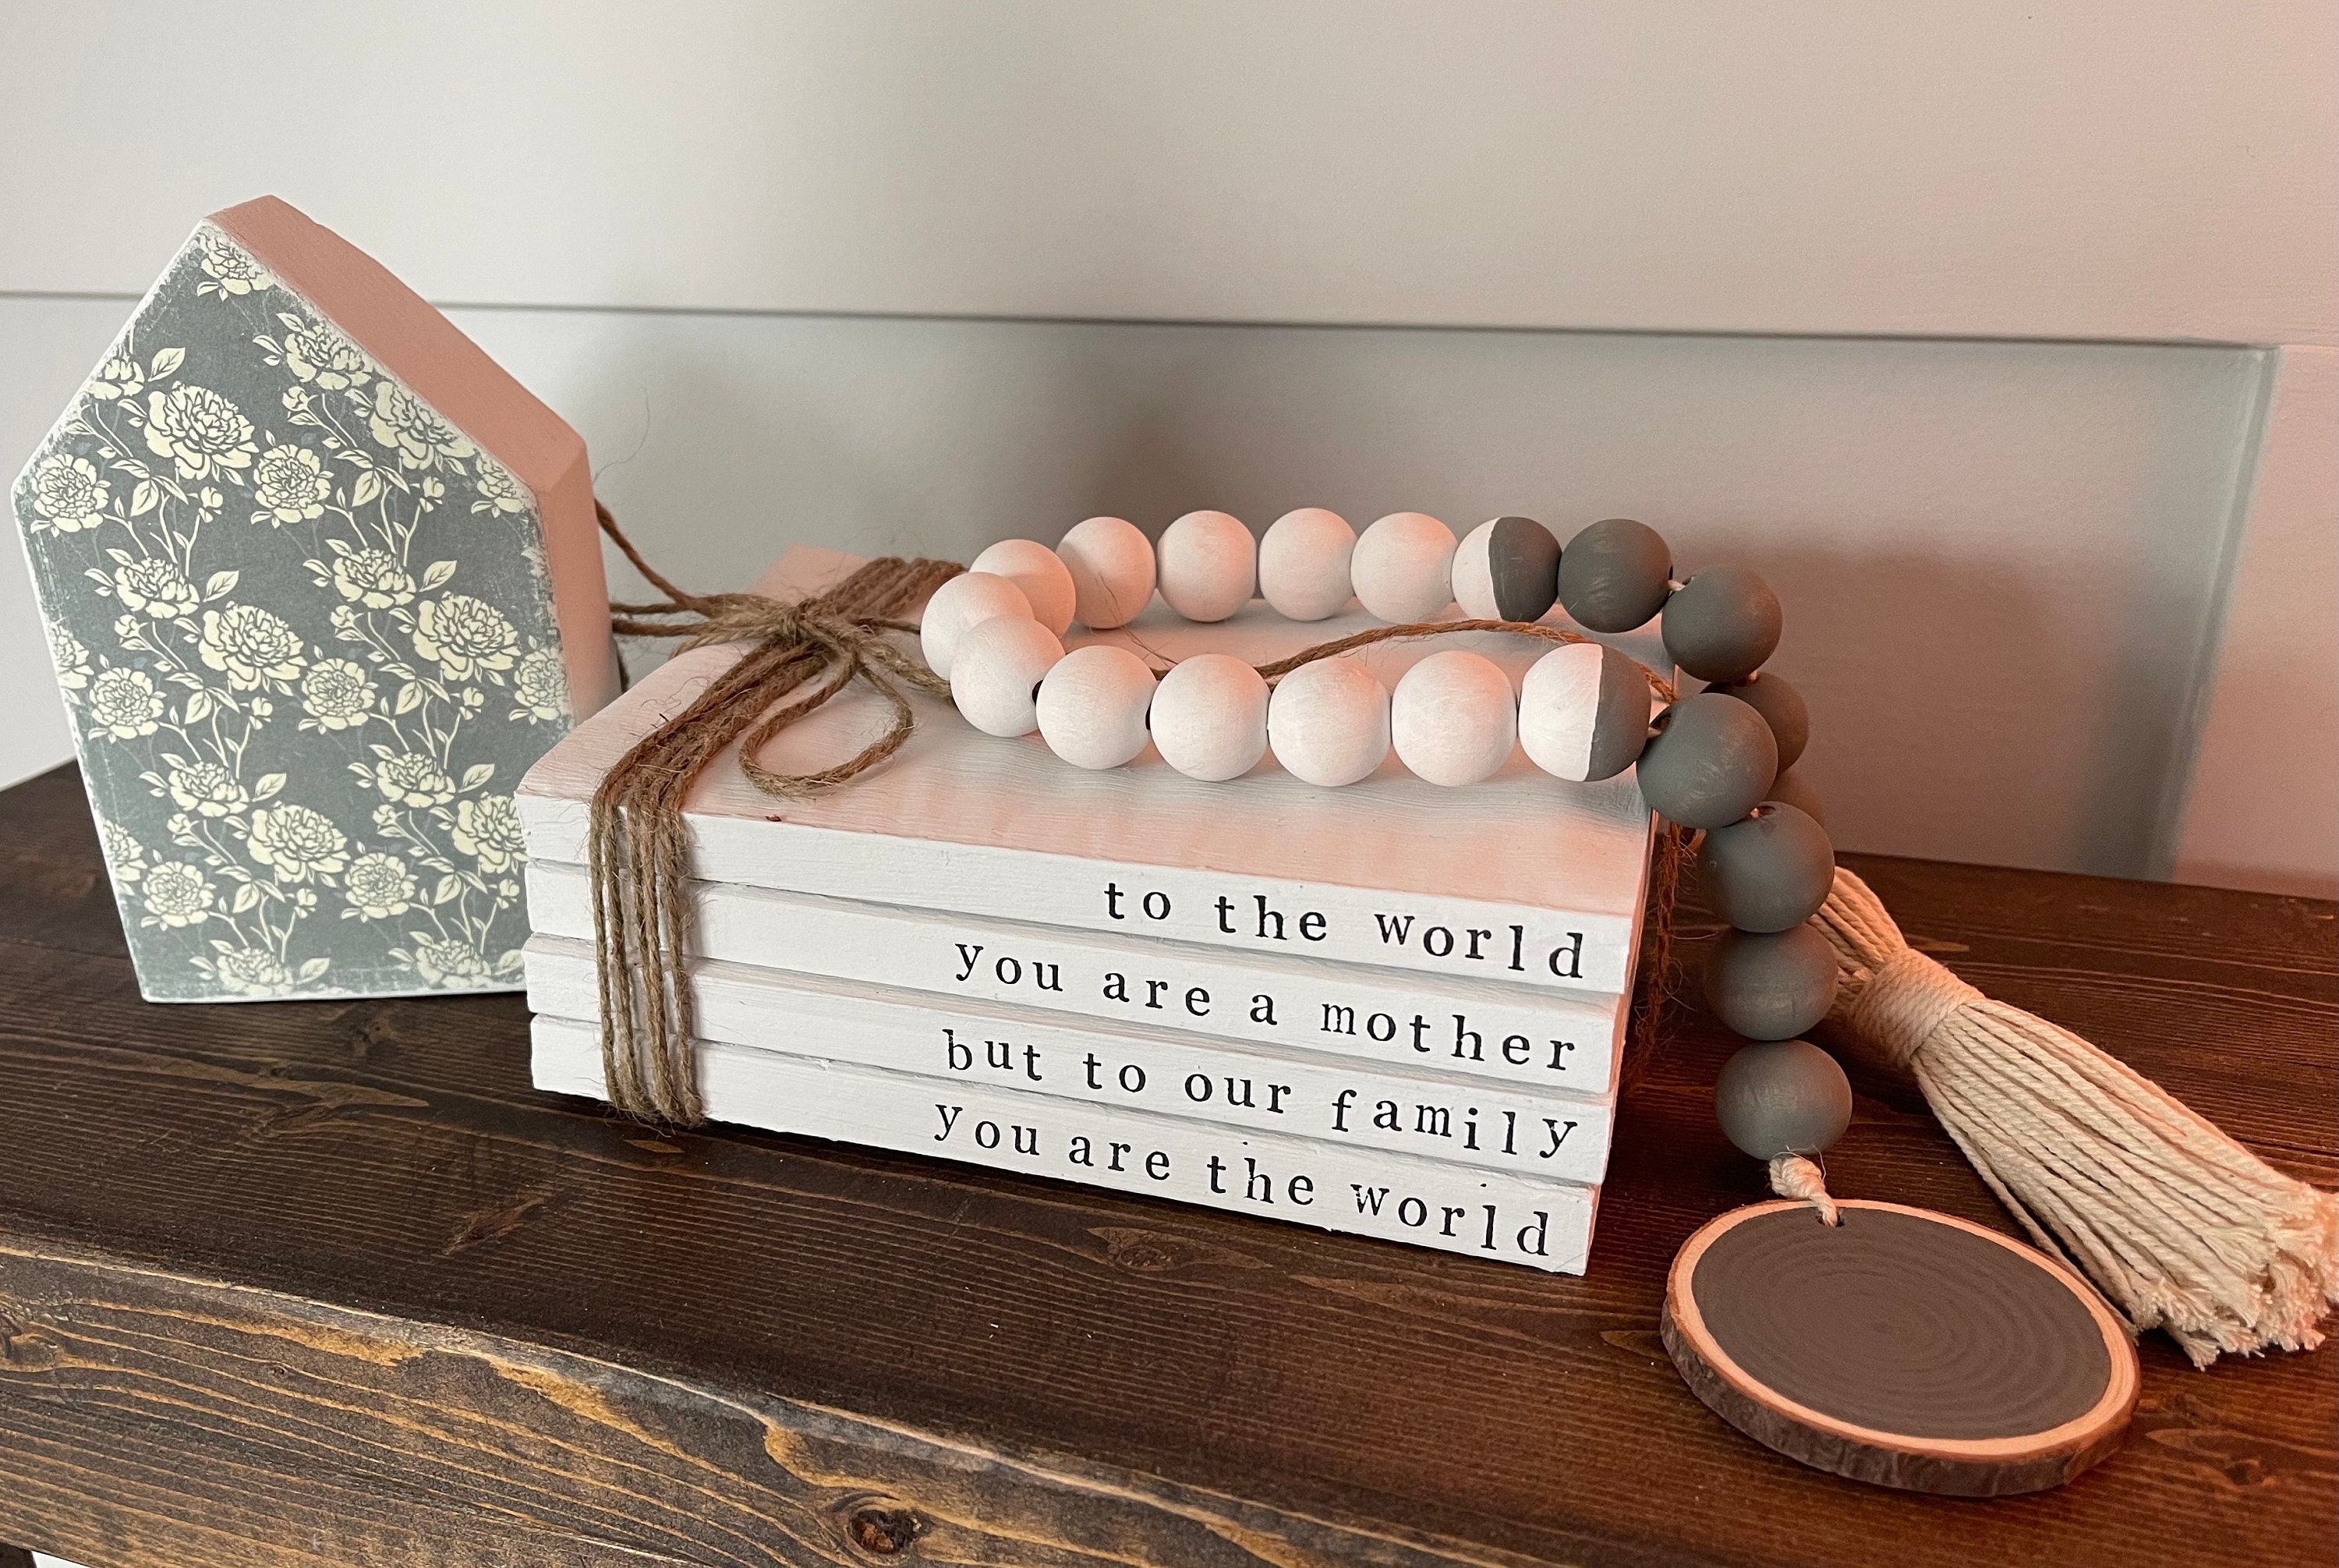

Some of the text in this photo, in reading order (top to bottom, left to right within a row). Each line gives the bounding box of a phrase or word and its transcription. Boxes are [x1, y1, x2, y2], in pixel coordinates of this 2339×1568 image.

[1102, 882, 1584, 979] to the world
[954, 942, 1576, 1072] you are a mother
[941, 1028, 1579, 1159] but to our family
[932, 1103, 1550, 1257] you are the world
